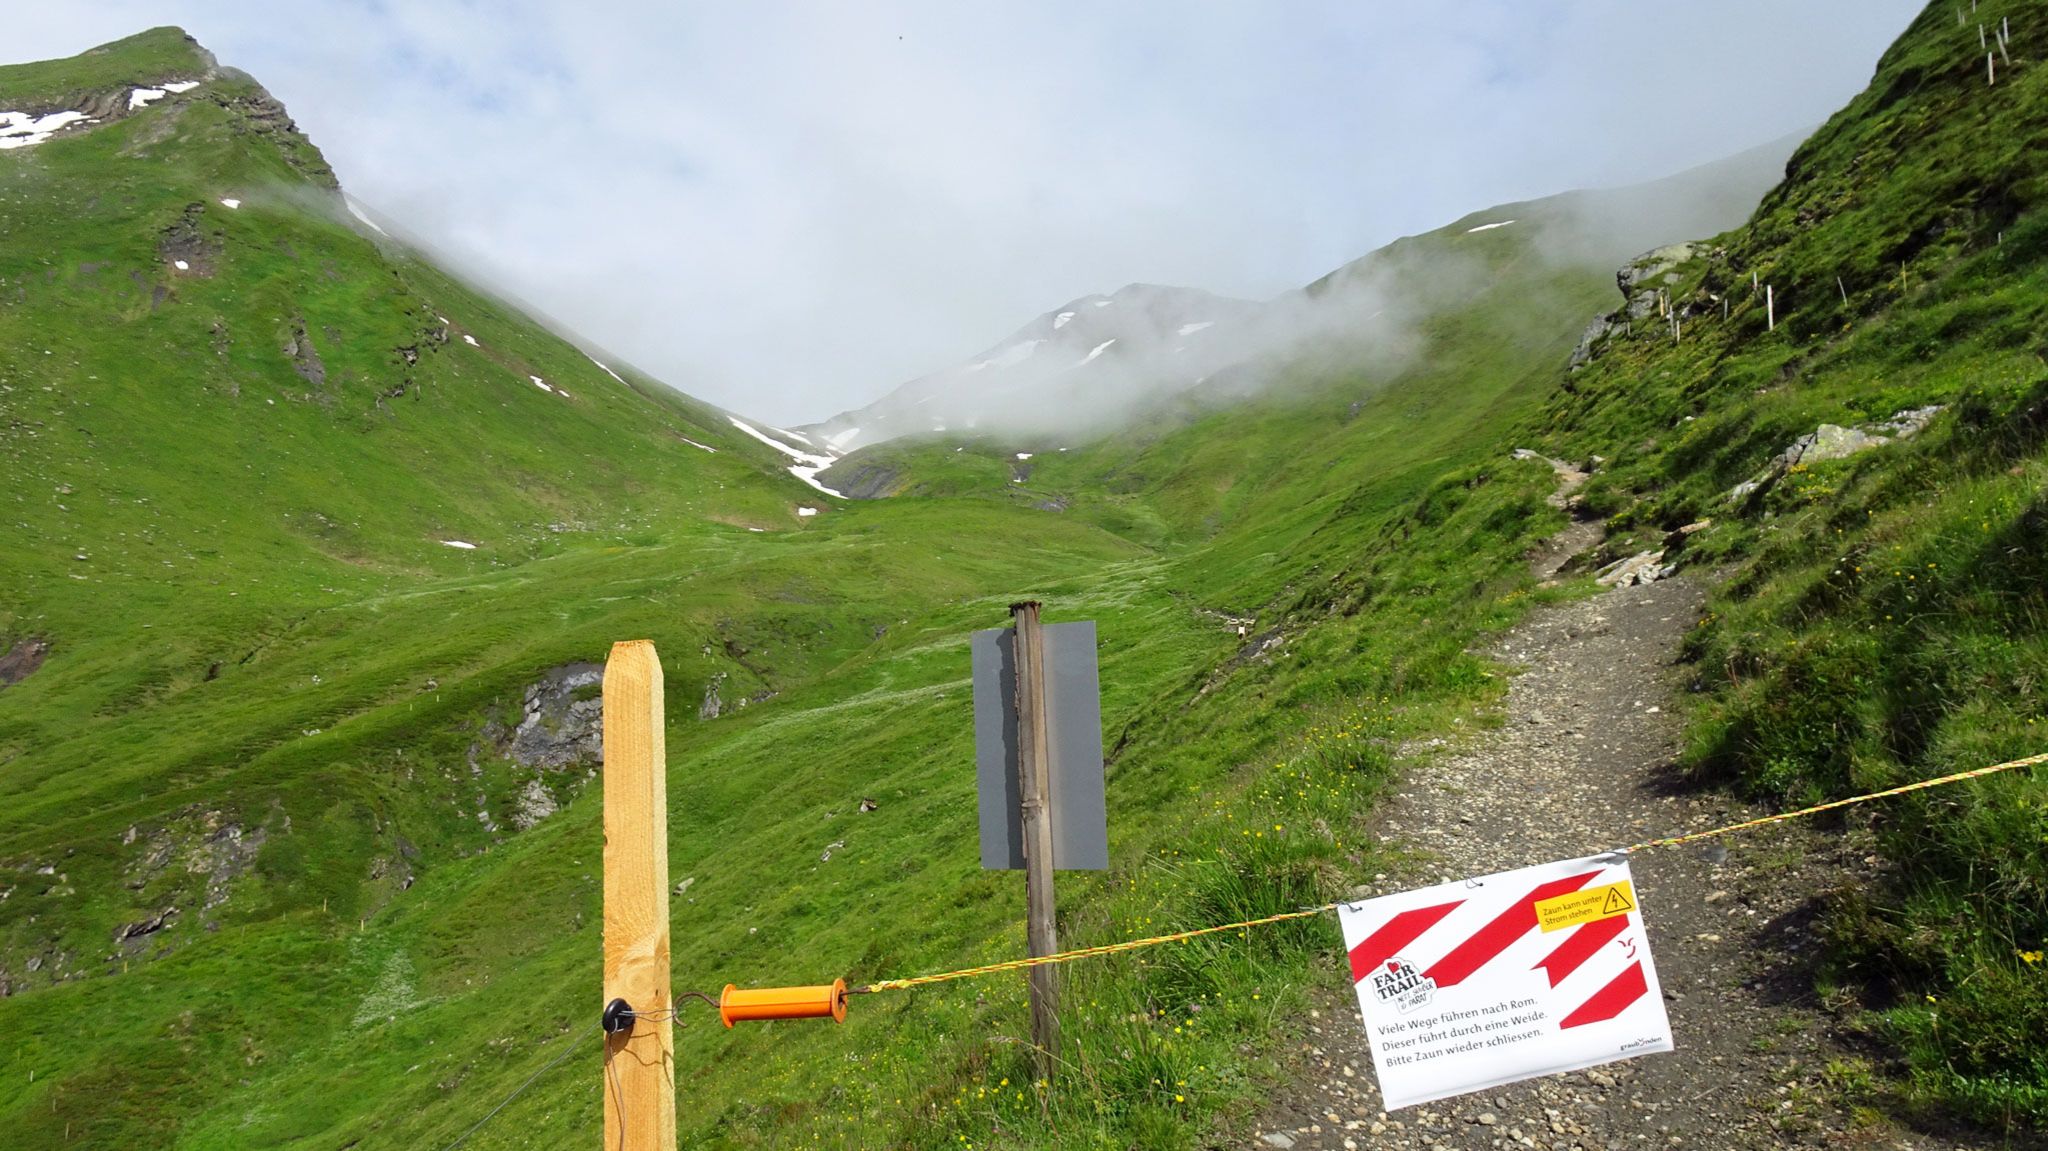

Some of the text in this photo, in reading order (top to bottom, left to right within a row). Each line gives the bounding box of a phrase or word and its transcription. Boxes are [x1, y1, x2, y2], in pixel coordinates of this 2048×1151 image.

[1543, 896, 1602, 916] Zaun kann unter
[1545, 908, 1593, 926] Strom stehen
[1377, 975, 1423, 1000] TRAIL
[1378, 998, 1538, 1035] Viele Wege führen nach Rom.
[1382, 1011, 1548, 1051] Dieser führt durch eine Weide.
[1386, 1029, 1544, 1067] Bitte Zaun wieder schliessen.
